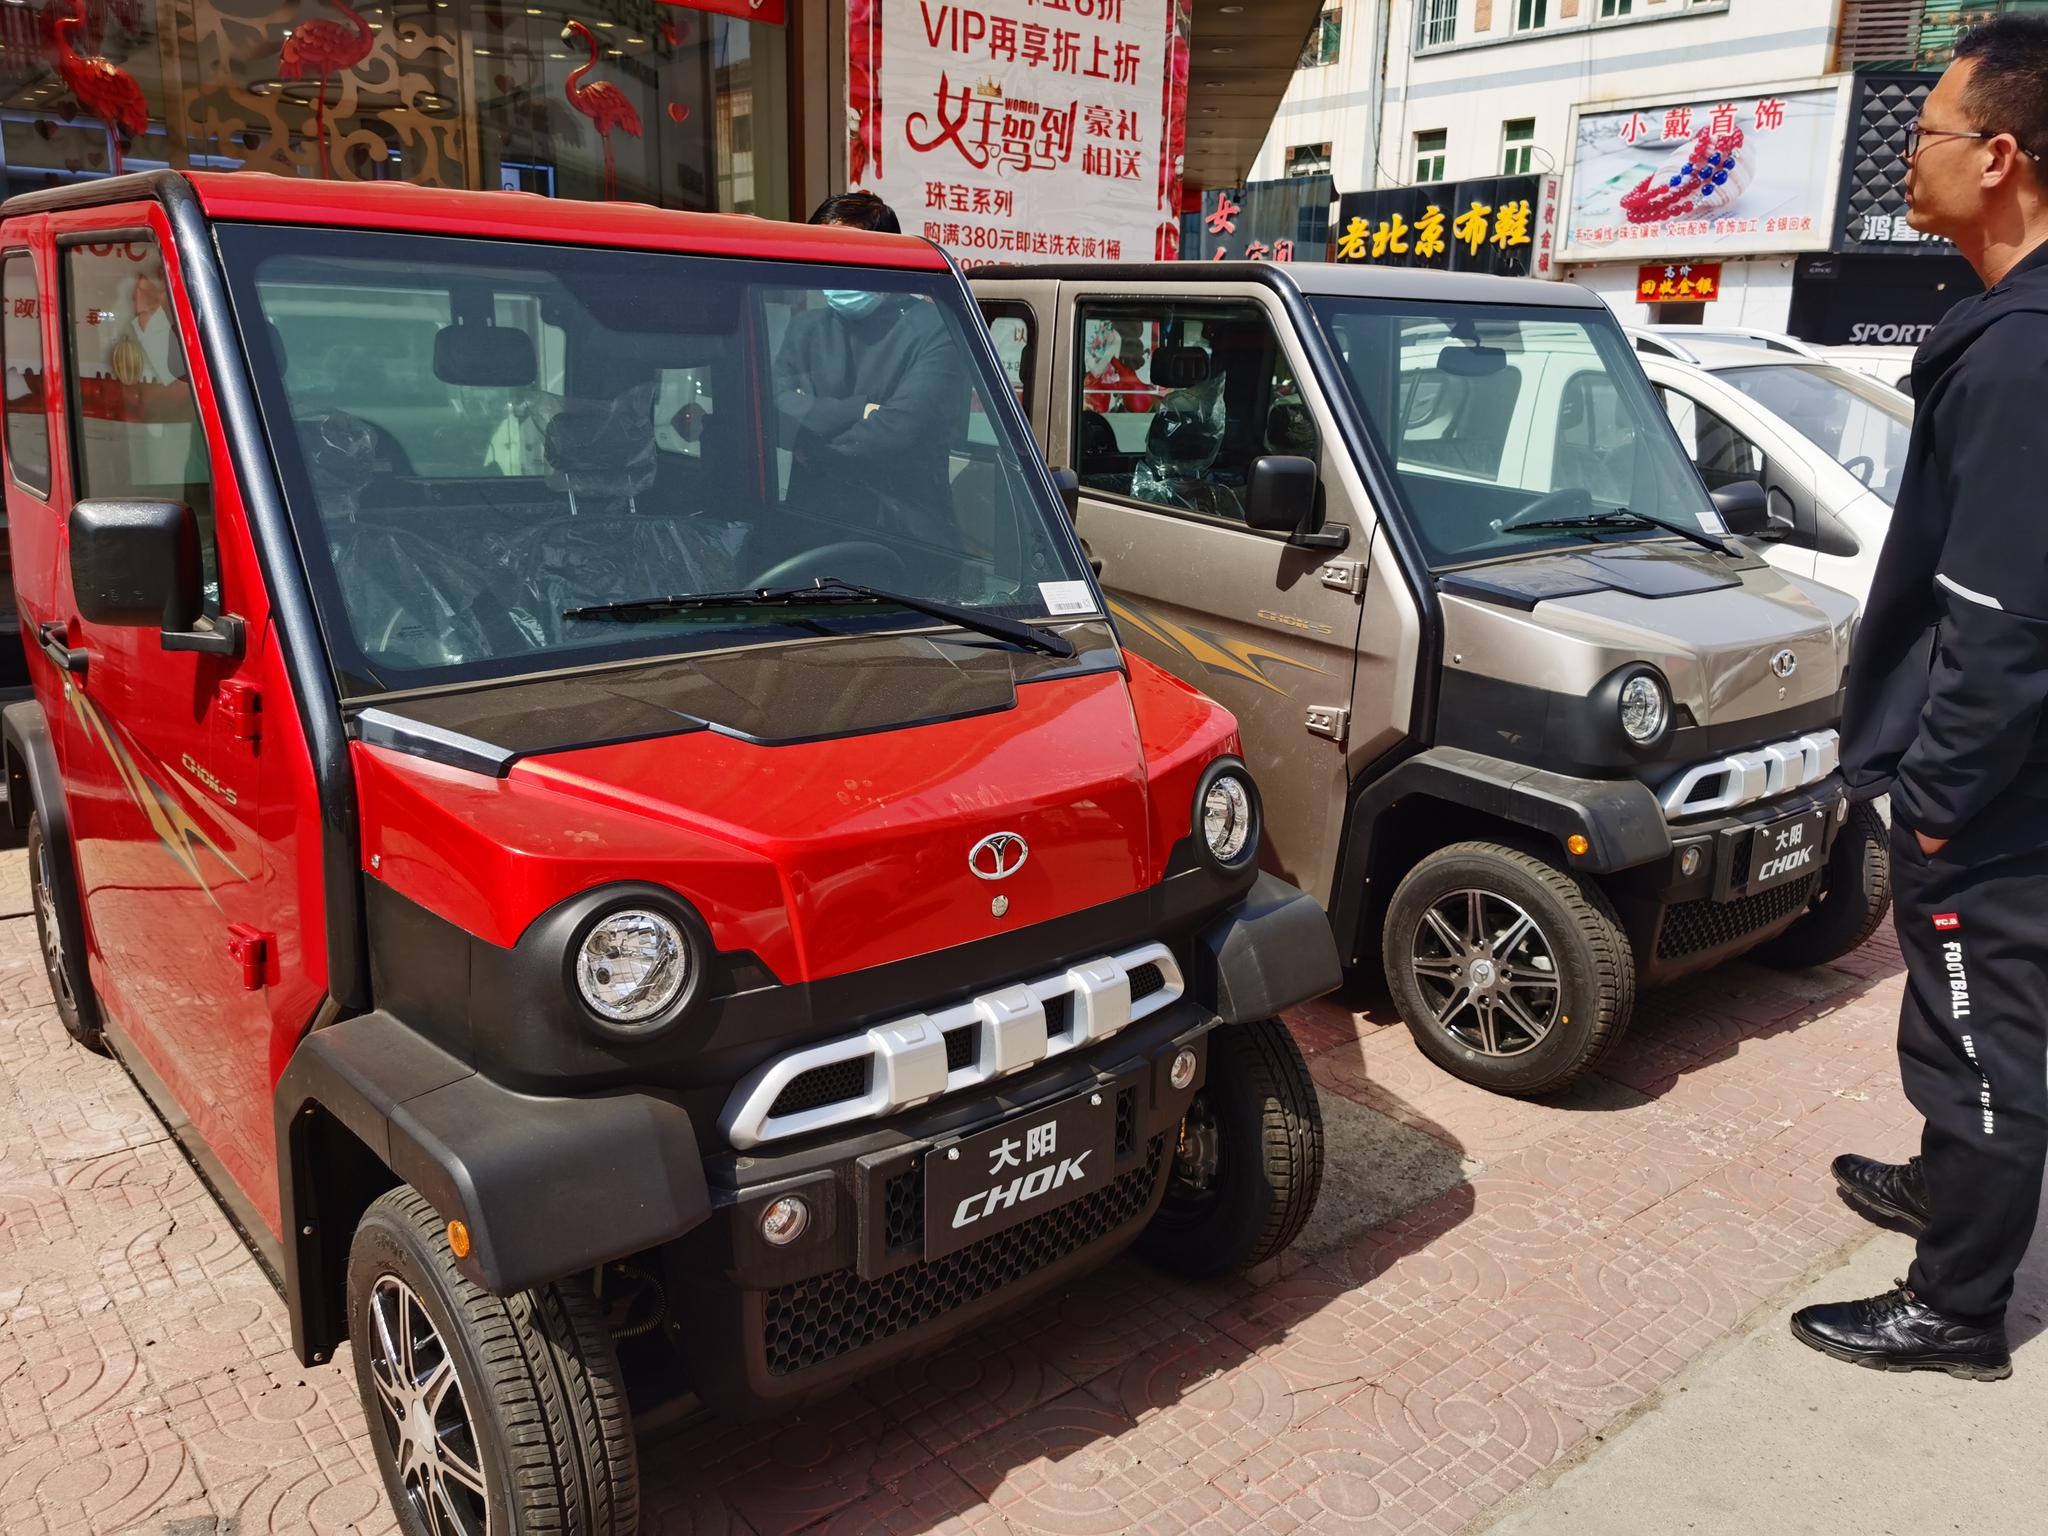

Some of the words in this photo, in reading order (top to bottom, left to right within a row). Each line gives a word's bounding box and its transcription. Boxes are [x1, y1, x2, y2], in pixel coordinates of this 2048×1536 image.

[920, 1, 1140, 85] VIP再享折上折
[905, 69, 1078, 176] 女王驾到
[1005, 97, 1039, 115] women
[1084, 105, 1143, 142] 豪礼
[1621, 99, 1786, 143] 小戴首饰
[1081, 144, 1142, 181] 相送
[925, 181, 1013, 217] 珠宝系列
[924, 221, 1121, 260] 购满380元即送洗衣液1桶
[1337, 200, 1531, 258] 老北京布鞋
[1860, 215, 1951, 241] 鸿星
[1641, 277, 1714, 295] 回收金银
[1849, 323, 1936, 343] SPORT
[1257, 609, 1333, 635] CHOK-S
[182, 752, 237, 805] CHOK-S
[1775, 822, 1803, 852] 大阳
[1758, 844, 1814, 881] CHOK
[1942, 941, 1971, 1019] FOOTBALL
[989, 1120, 1056, 1175] 大阳
[952, 1149, 1093, 1229] CHOK
